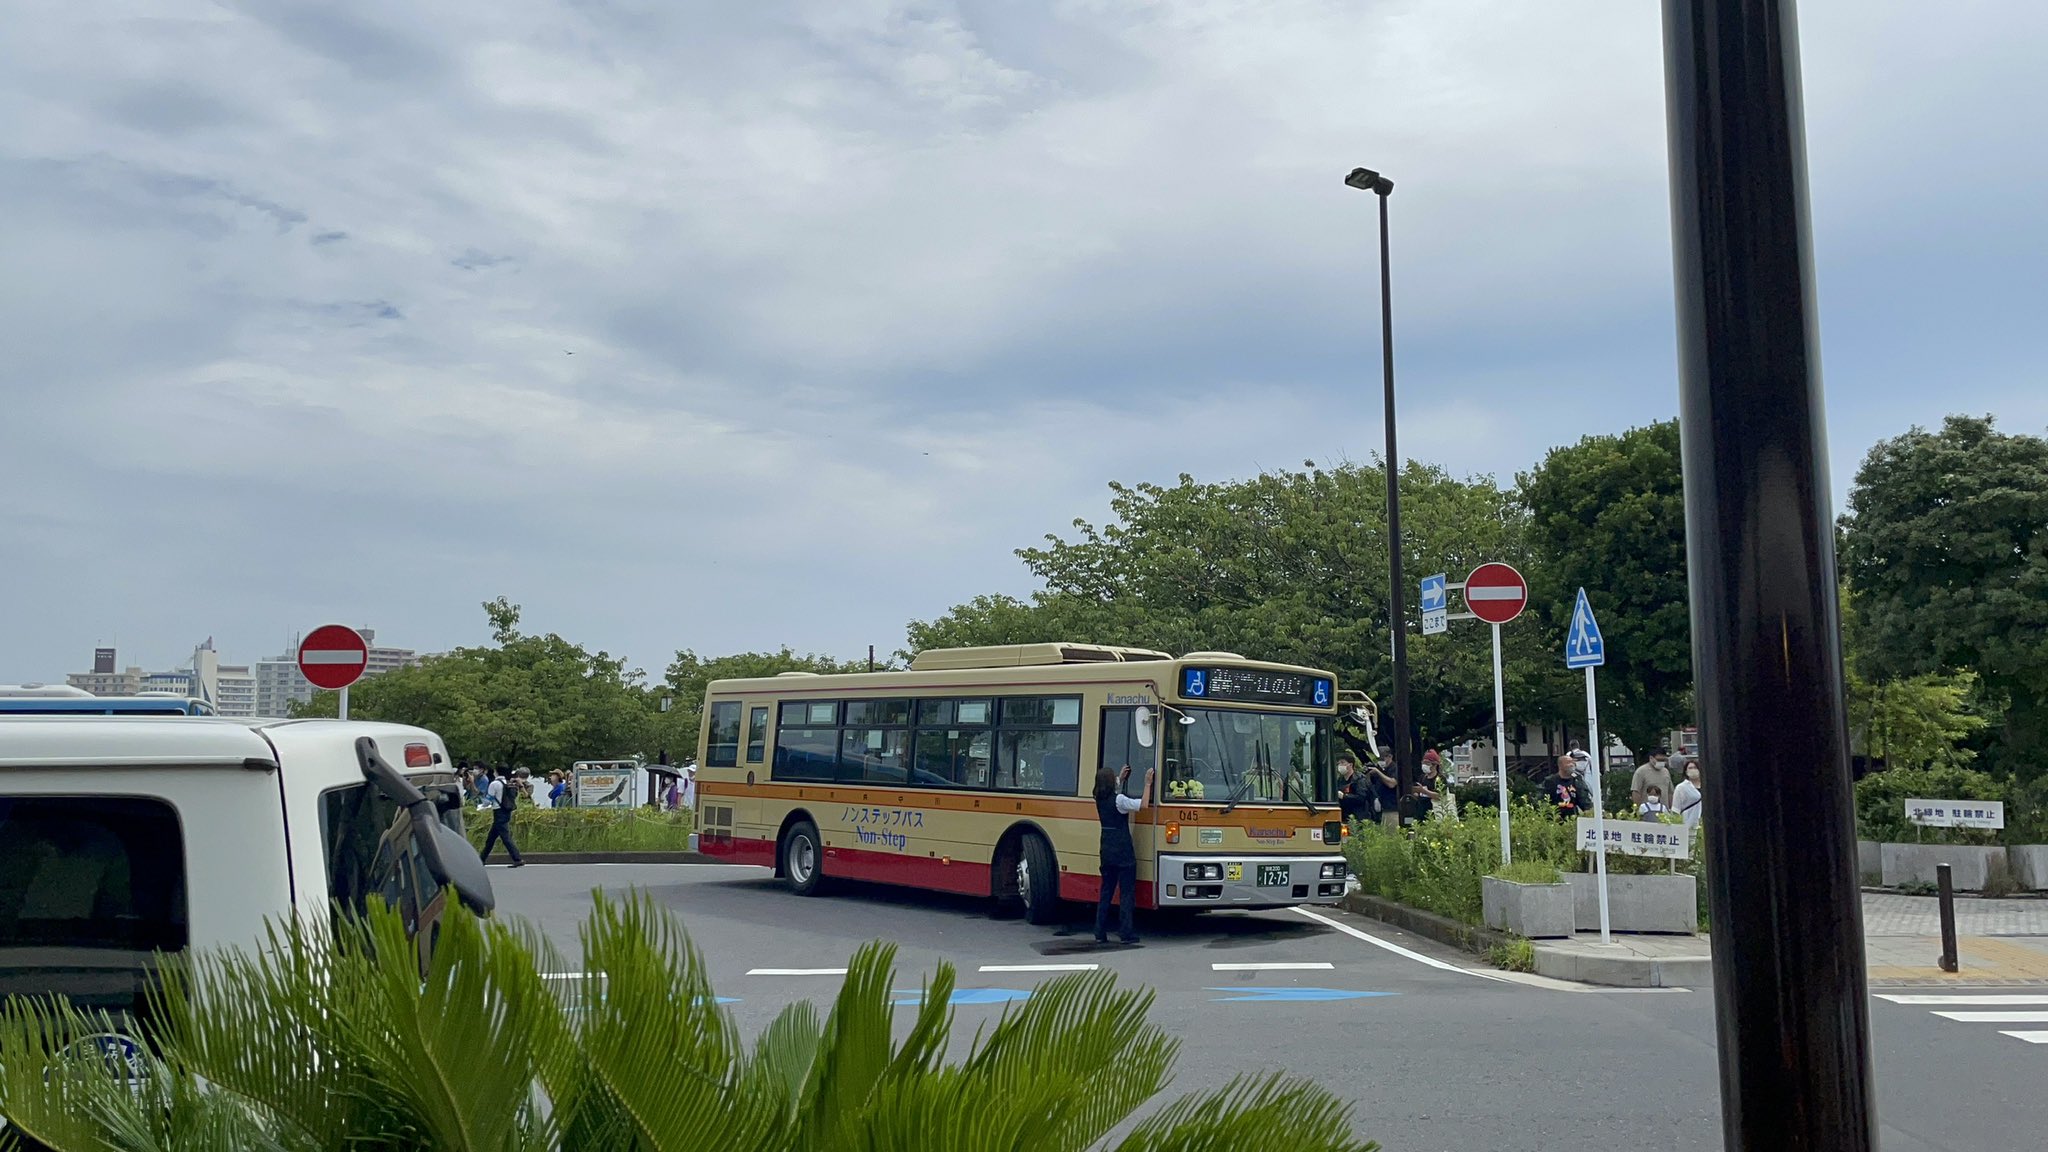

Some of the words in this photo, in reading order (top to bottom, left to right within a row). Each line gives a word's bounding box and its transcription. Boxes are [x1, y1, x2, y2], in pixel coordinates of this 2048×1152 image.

[1424, 615, 1445, 630] ここまで
[1107, 692, 1150, 705] Kanachu
[841, 806, 924, 828] ノンステップバス
[1952, 809, 1996, 819] 駐輪禁止
[855, 825, 906, 851] Non-Step
[1631, 832, 1680, 846] 駐輪禁止
